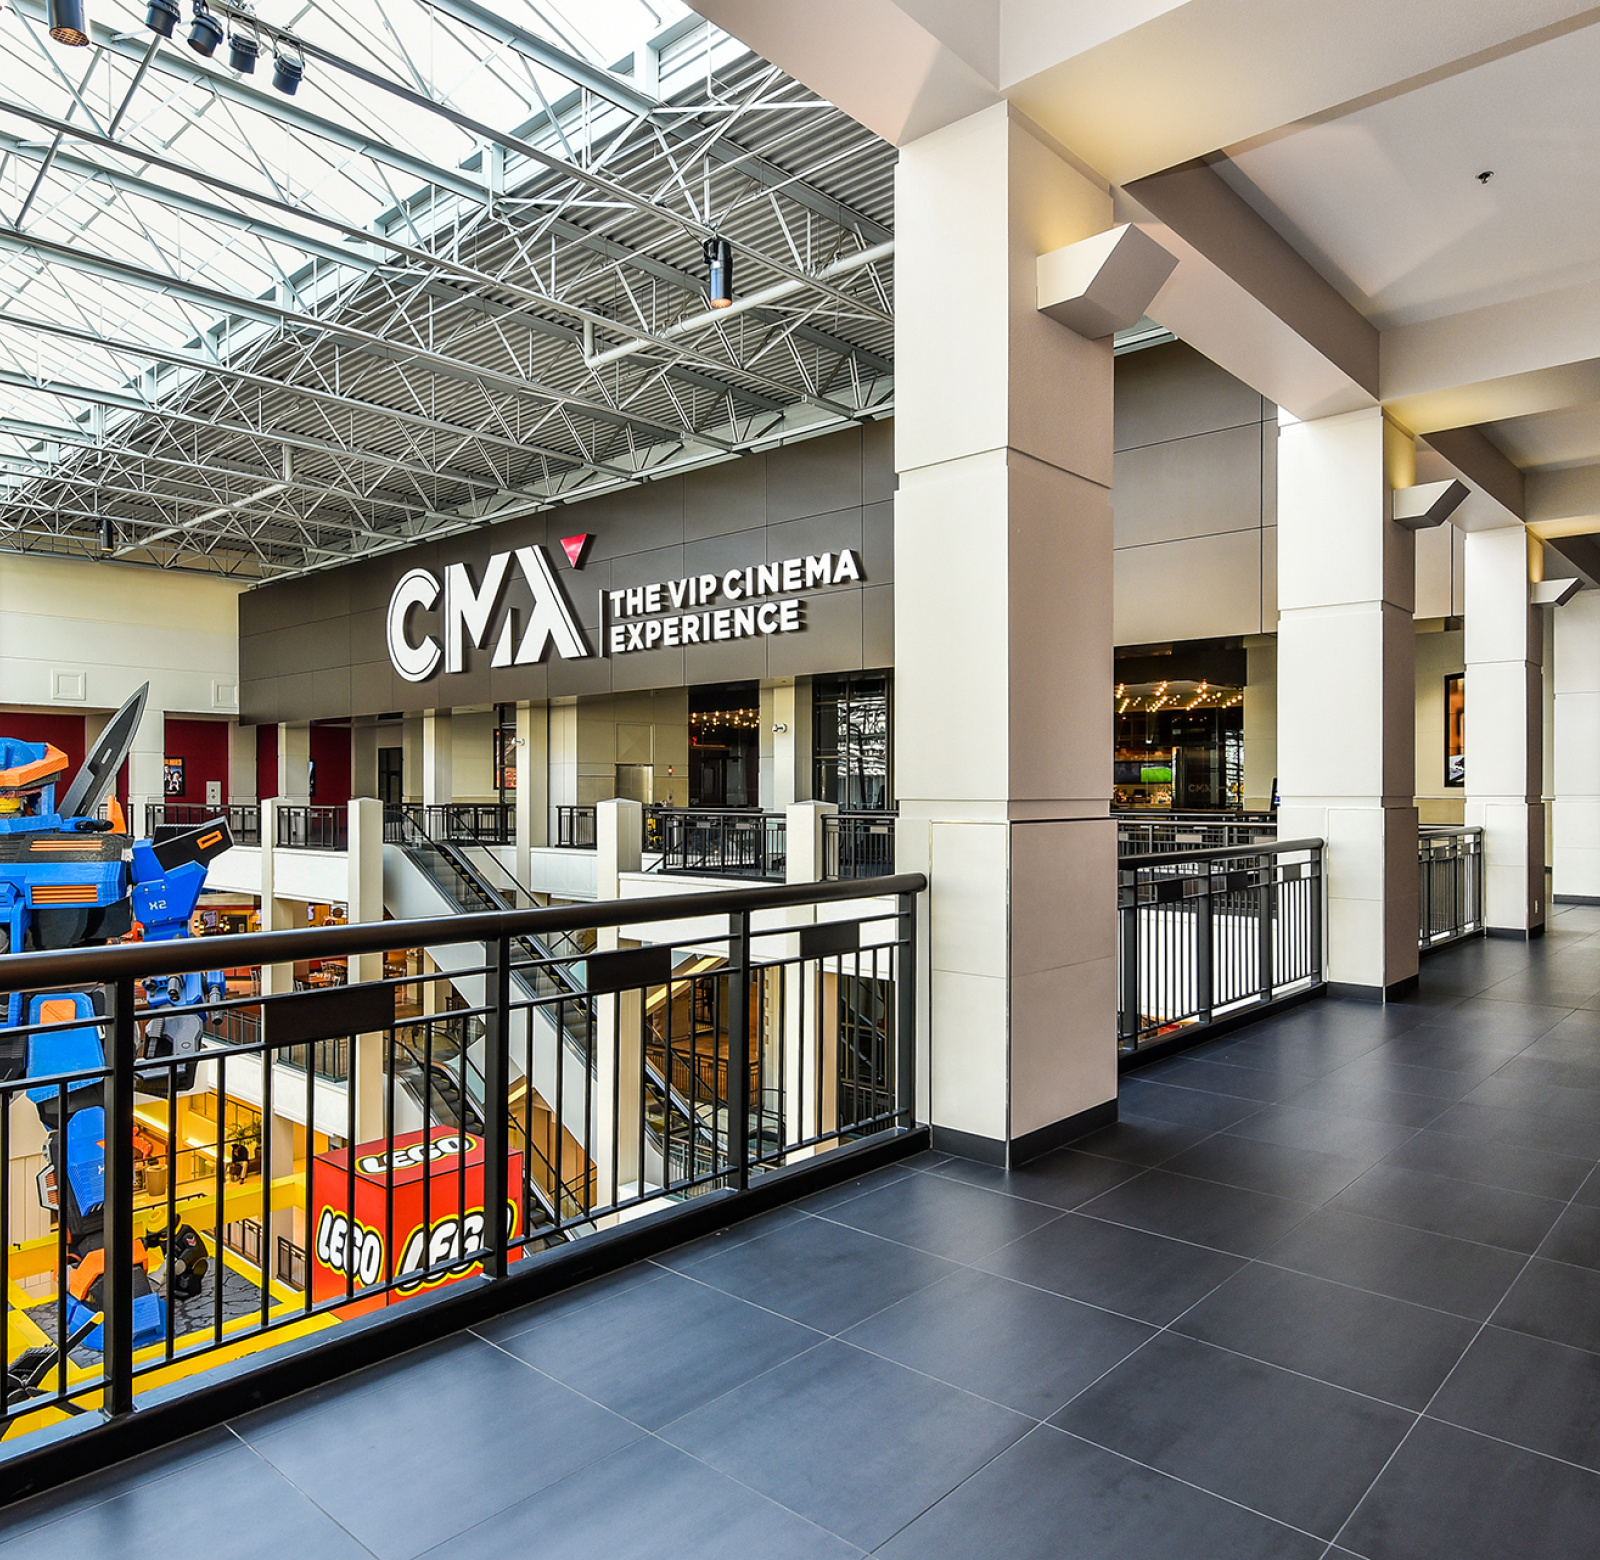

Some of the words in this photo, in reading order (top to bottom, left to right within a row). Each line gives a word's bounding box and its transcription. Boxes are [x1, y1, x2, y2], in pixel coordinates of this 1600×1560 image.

[386, 544, 588, 682] CMX
[609, 583, 661, 617] THE
[667, 573, 717, 608] VIP
[722, 548, 860, 601] CINEMA
[610, 599, 800, 653] EXPERIENCE
[148, 899, 168, 911] X2
[361, 1137, 470, 1173] LEGO
[318, 1212, 381, 1285] LEGO
[401, 1206, 511, 1288] LEG
